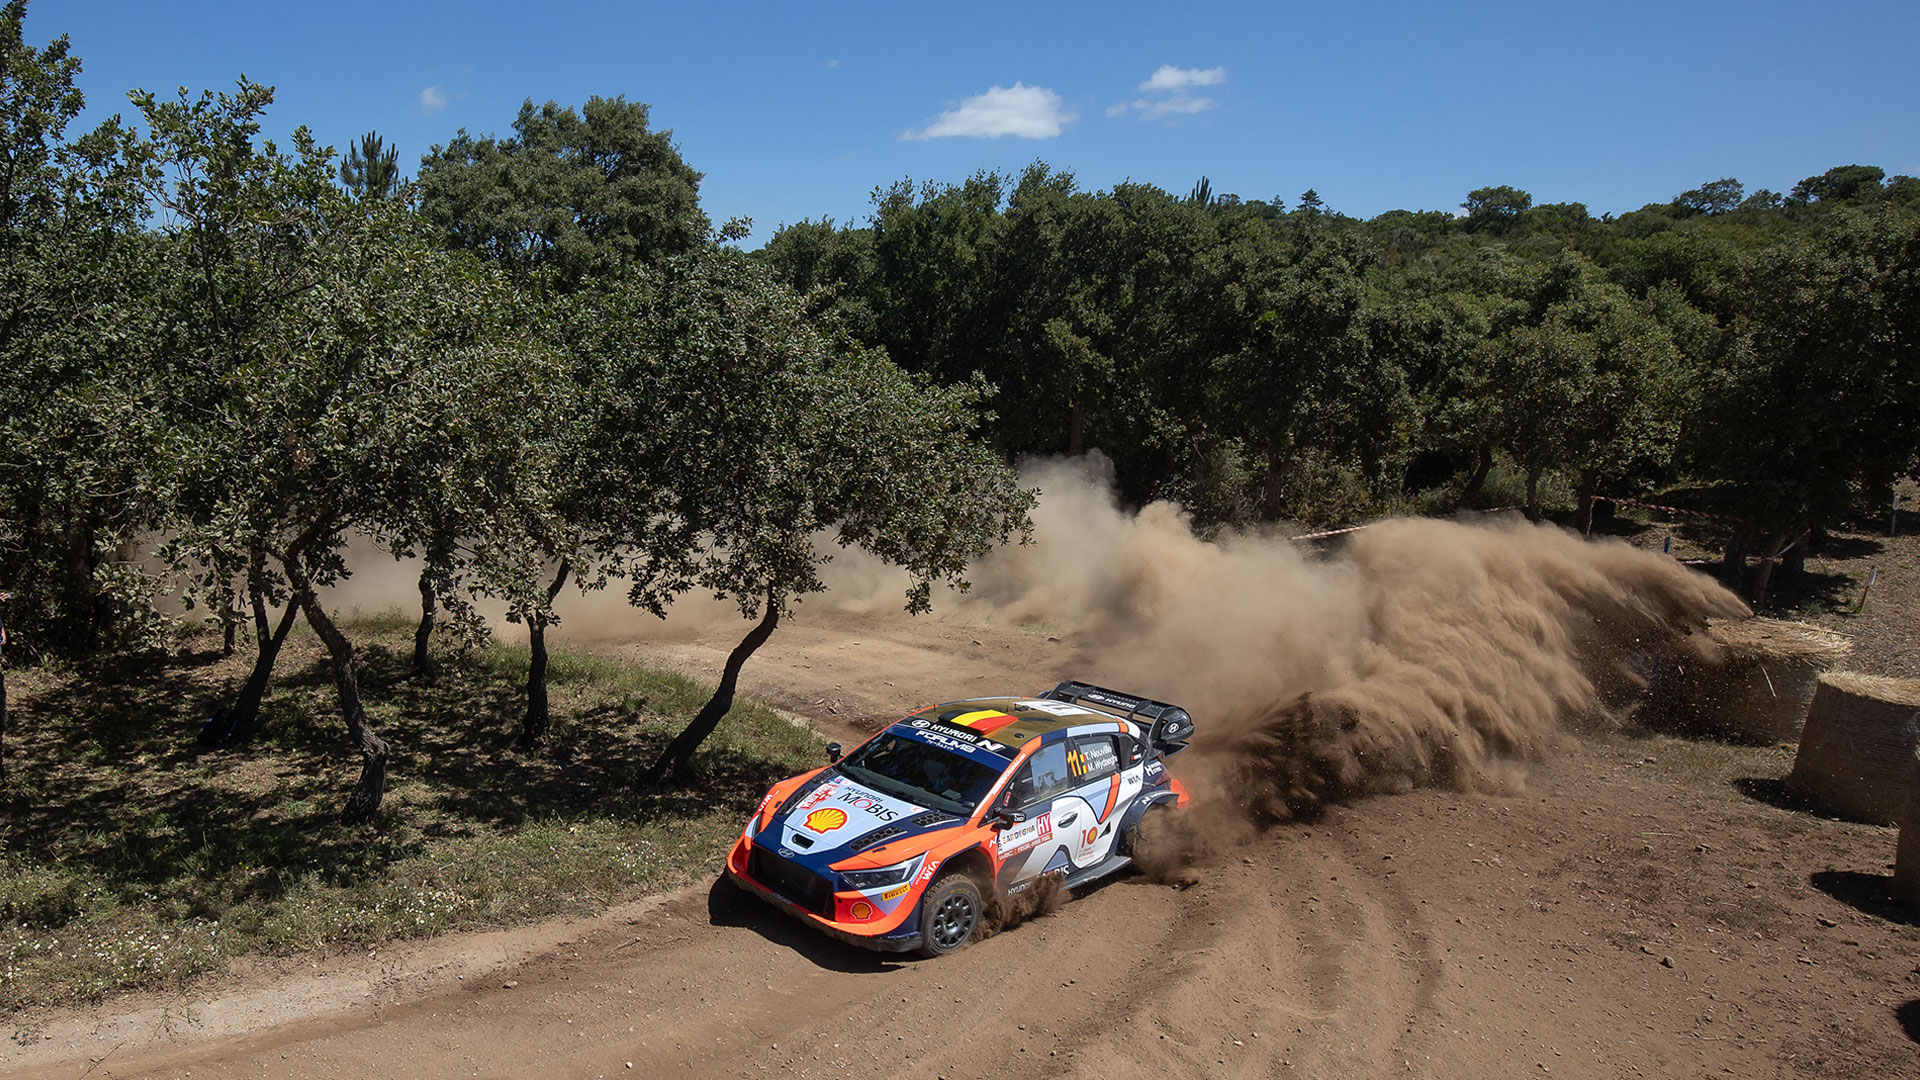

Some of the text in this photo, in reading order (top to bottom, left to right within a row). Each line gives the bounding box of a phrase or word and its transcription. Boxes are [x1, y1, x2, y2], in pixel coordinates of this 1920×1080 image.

[1105, 698, 1136, 709] HYUND
[930, 723, 1006, 751] HYUNDAI N
[1090, 744, 1113, 758] Neuville
[1067, 749, 1082, 777] 11
[844, 786, 884, 803] HYUNDAI
[837, 792, 899, 821] MOBIS
[1002, 825, 1036, 845] SARDEGNA
[922, 861, 940, 881] WIA
[884, 885, 909, 899] PIRELLI
